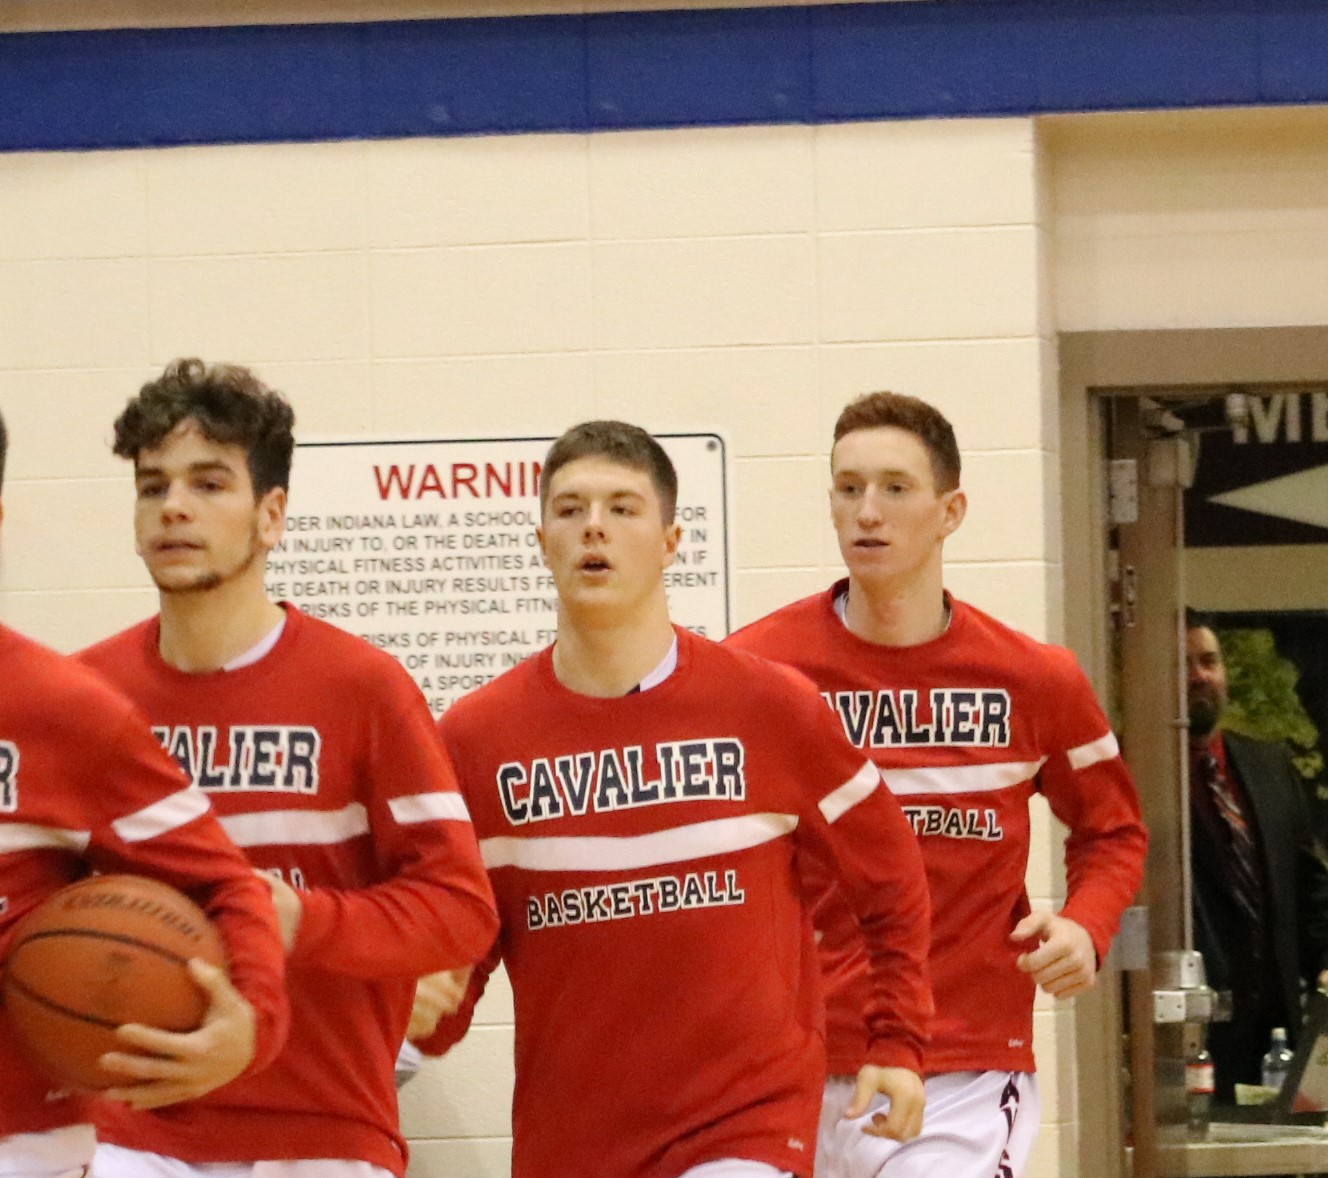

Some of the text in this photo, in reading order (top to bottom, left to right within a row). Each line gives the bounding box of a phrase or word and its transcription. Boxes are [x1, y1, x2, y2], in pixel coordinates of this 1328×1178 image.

[372, 461, 542, 501] WARNI
[326, 514, 397, 530] INDIANA
[448, 512, 460, 527] A
[464, 511, 537, 527] SCHOOL
[293, 537, 354, 553] INJURY
[393, 535, 418, 551] OR
[424, 534, 457, 549] THE
[463, 532, 519, 549] DEATH
[690, 528, 707, 543] IN
[265, 559, 350, 575] PHYSICAL
[354, 556, 425, 574] FITNESS
[431, 555, 524, 571] ACTIVITIES
[692, 550, 707, 565] IF
[292, 581, 350, 597] DEATH
[355, 580, 380, 595] OR
[385, 578, 446, 595] INJURY
[452, 576, 530, 592] RESULTS
[357, 601, 380, 617] OF
[386, 600, 419, 616] THE
[424, 599, 510, 615] PHYSICAL
[416, 632, 440, 647] OF
[445, 630, 531, 646] PHYSICAL
[405, 654, 429, 670] OF
[435, 652, 496, 668] INJURY
[421, 676, 432, 690] A
[820, 687, 1012, 749] VALIER
[496, 736, 746, 826] CAVALIER
[527, 870, 745, 930] BASKETBALL
